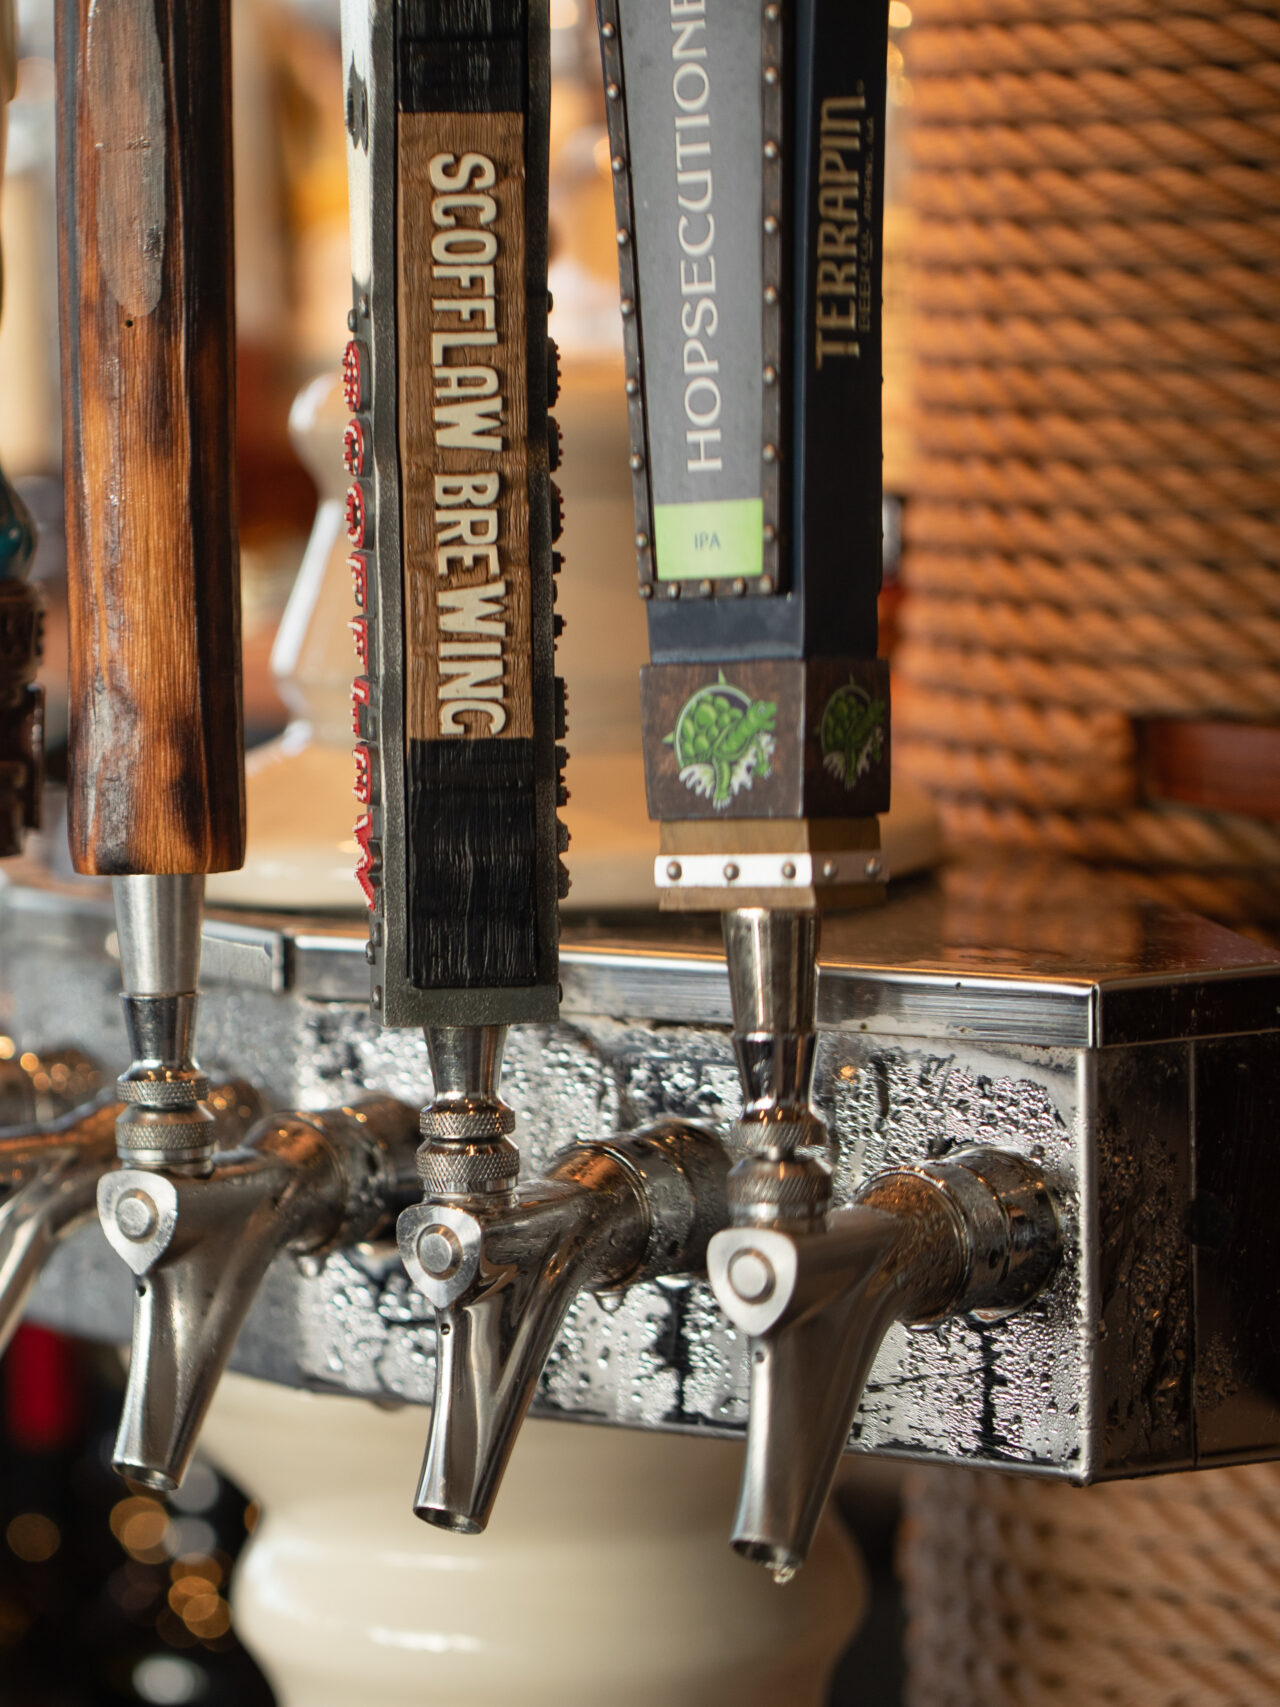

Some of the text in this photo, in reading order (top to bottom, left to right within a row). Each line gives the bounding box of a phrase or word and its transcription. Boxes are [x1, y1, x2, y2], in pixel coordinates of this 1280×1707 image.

[816, 95, 867, 371] TERRAPIN
[429, 151, 507, 736] SCOFFLAW BREWING
[693, 531, 722, 552] IPA
